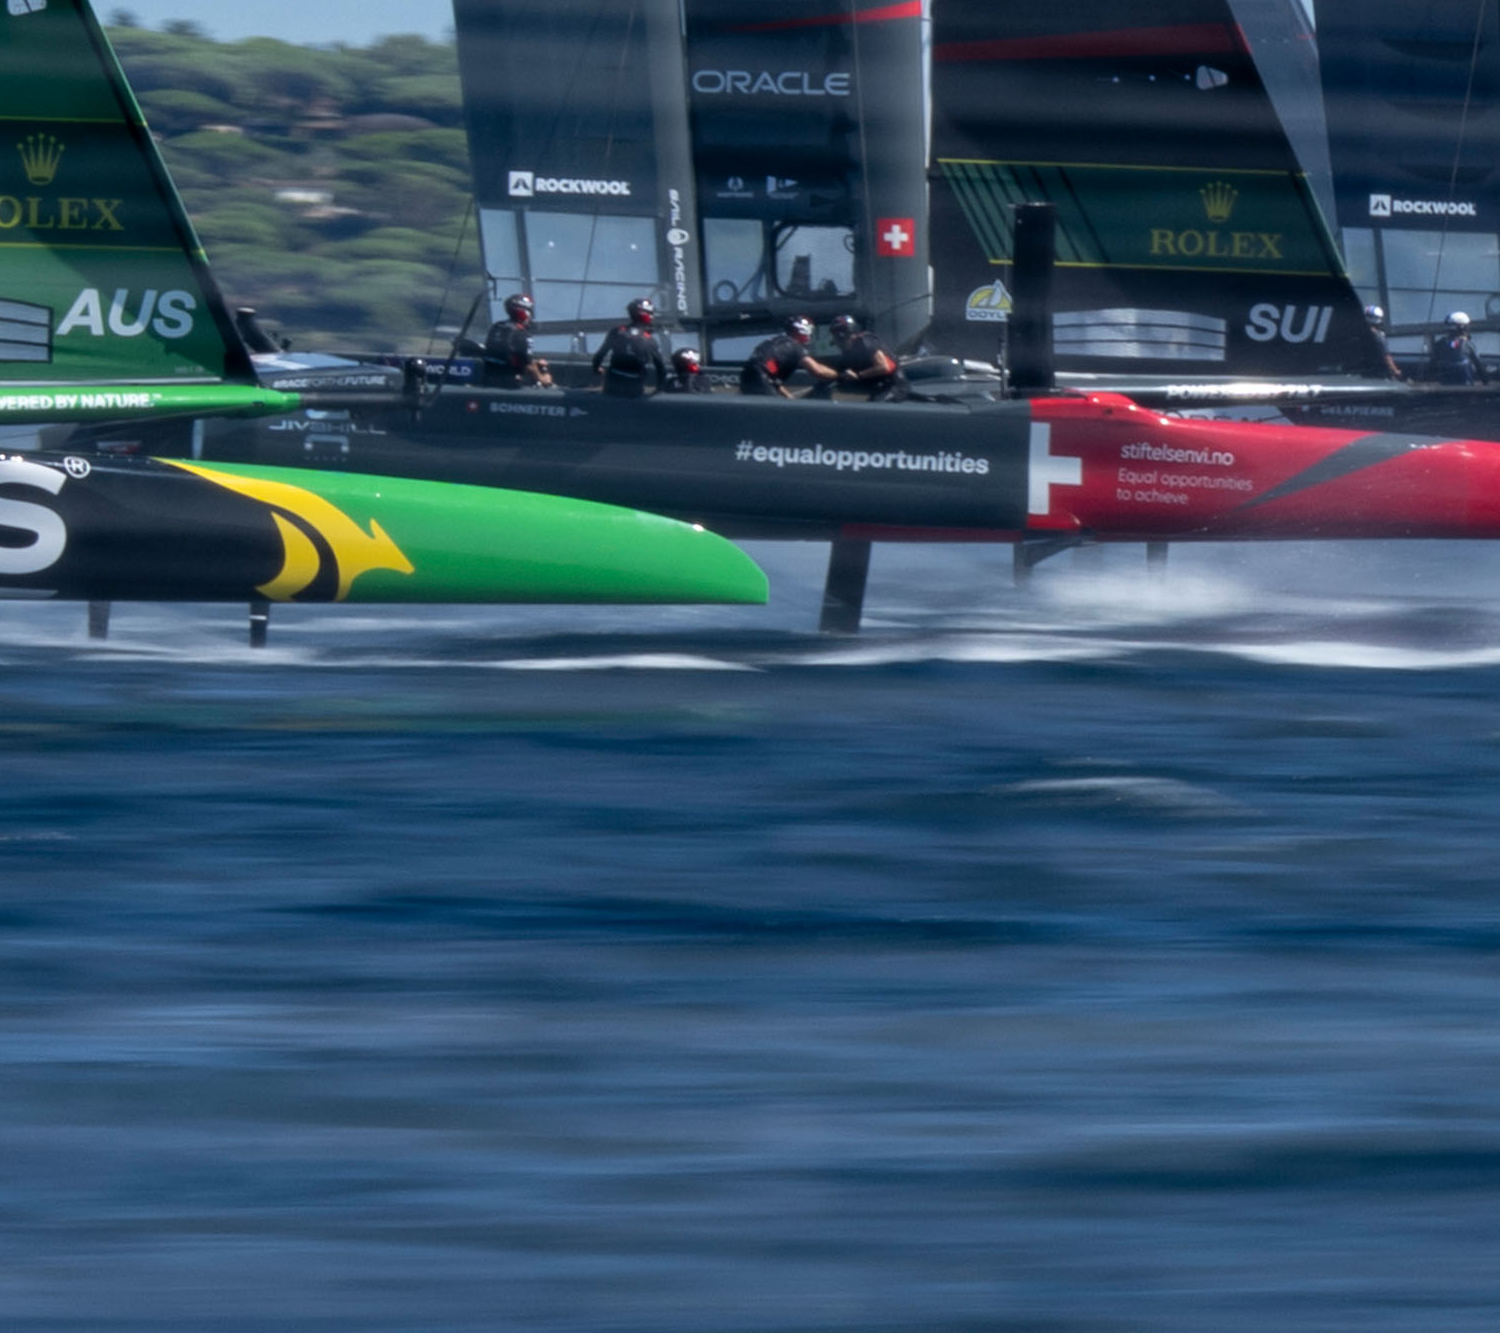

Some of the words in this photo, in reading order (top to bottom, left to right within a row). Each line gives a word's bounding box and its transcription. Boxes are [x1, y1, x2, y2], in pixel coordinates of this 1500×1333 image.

[691, 68, 851, 96] ORACLE
[534, 176, 631, 196] ROCKWOOL
[1392, 198, 1477, 217] ROCKWOOL
[1149, 228, 1284, 260] ROLEX
[56, 287, 197, 338] AUS
[968, 310, 1005, 319] DOYL
[1244, 302, 1334, 344] SUI
[53, 394, 78, 410] BY
[734, 439, 991, 475] #equalopportunities
[1117, 467, 1158, 485] Equal
[1159, 473, 1253, 492] opportunities
[1116, 487, 1131, 501] to
[1133, 489, 1190, 506] achieve
